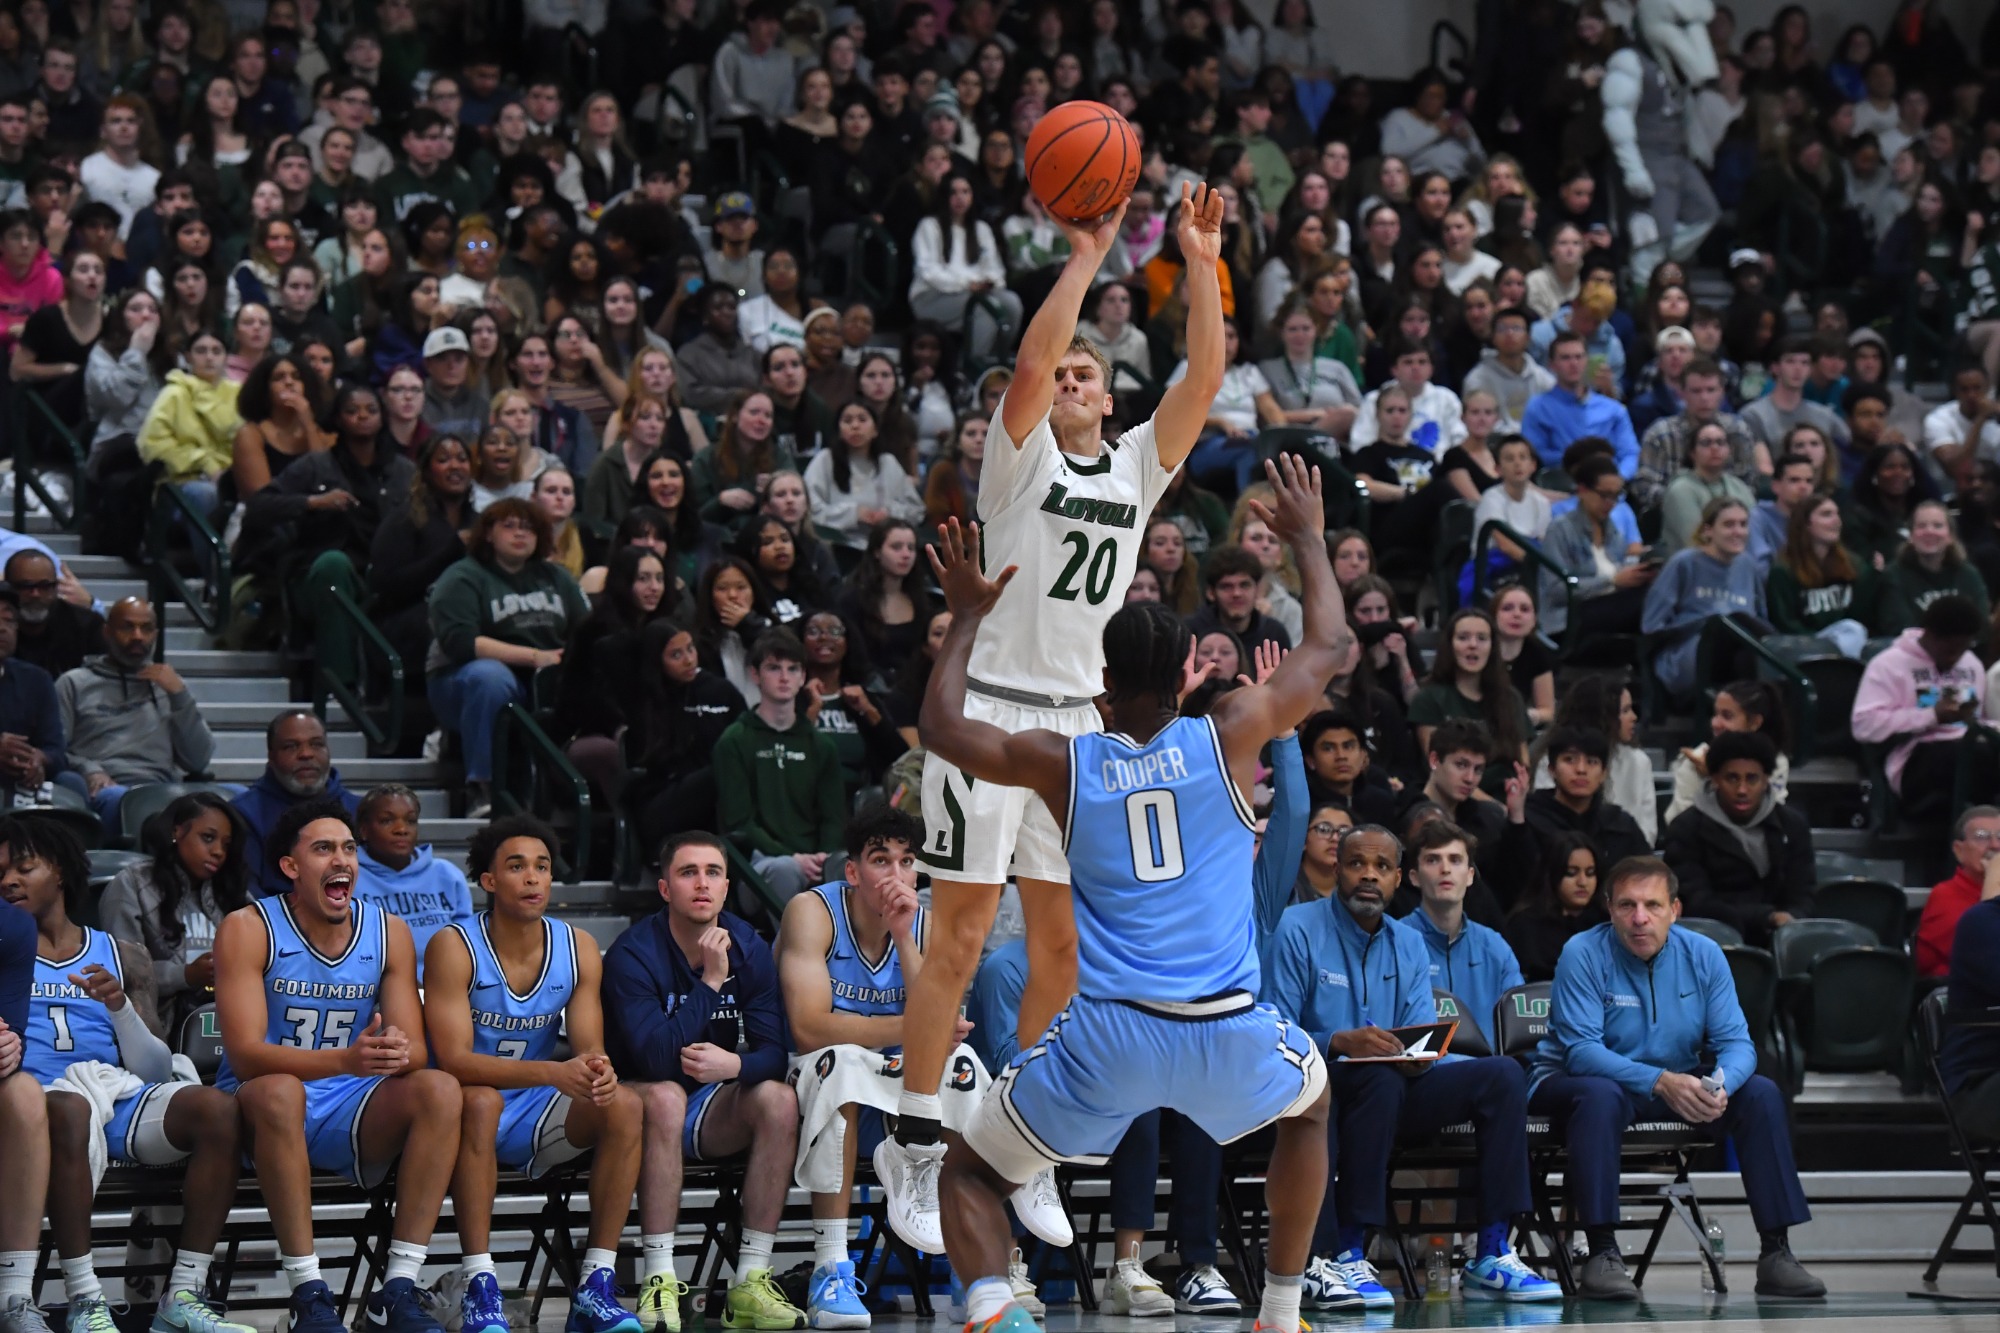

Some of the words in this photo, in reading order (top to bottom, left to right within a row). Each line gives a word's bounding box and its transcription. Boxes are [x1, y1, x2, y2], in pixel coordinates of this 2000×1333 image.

[1047, 530, 1118, 606] 20
[1102, 746, 1189, 793] COOPER
[935, 829, 948, 852] L
[1124, 787, 1186, 883] 0
[273, 978, 376, 1000] COLUMBIA
[48, 1005, 74, 1052] 1
[279, 1006, 358, 1050] 35
